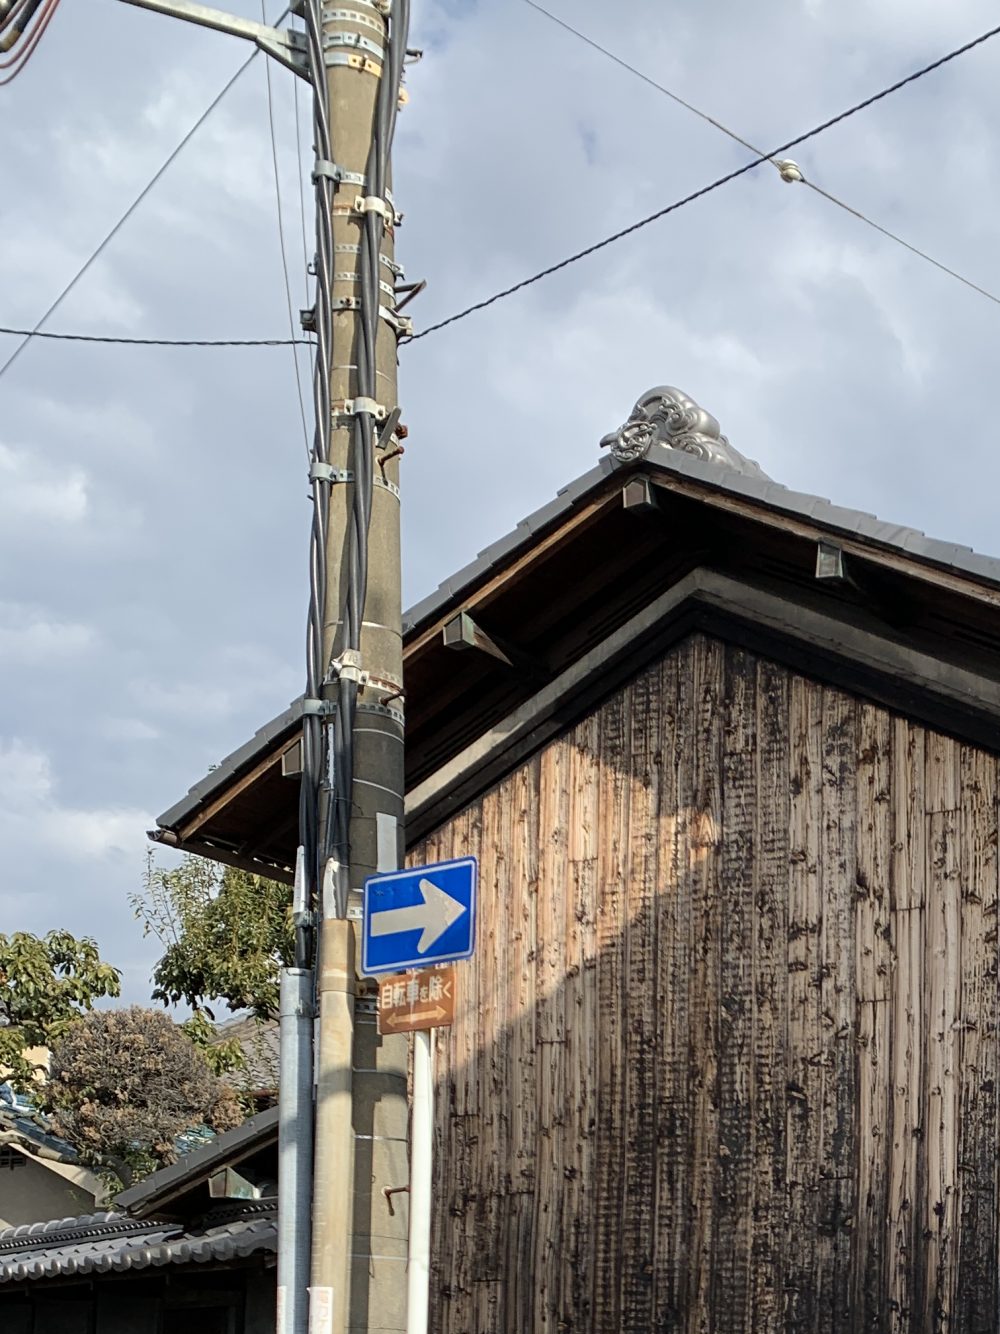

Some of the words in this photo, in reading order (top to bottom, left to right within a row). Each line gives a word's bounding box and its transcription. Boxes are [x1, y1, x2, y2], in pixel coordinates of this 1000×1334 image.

[382, 975, 452, 1009] 自転車を除く
